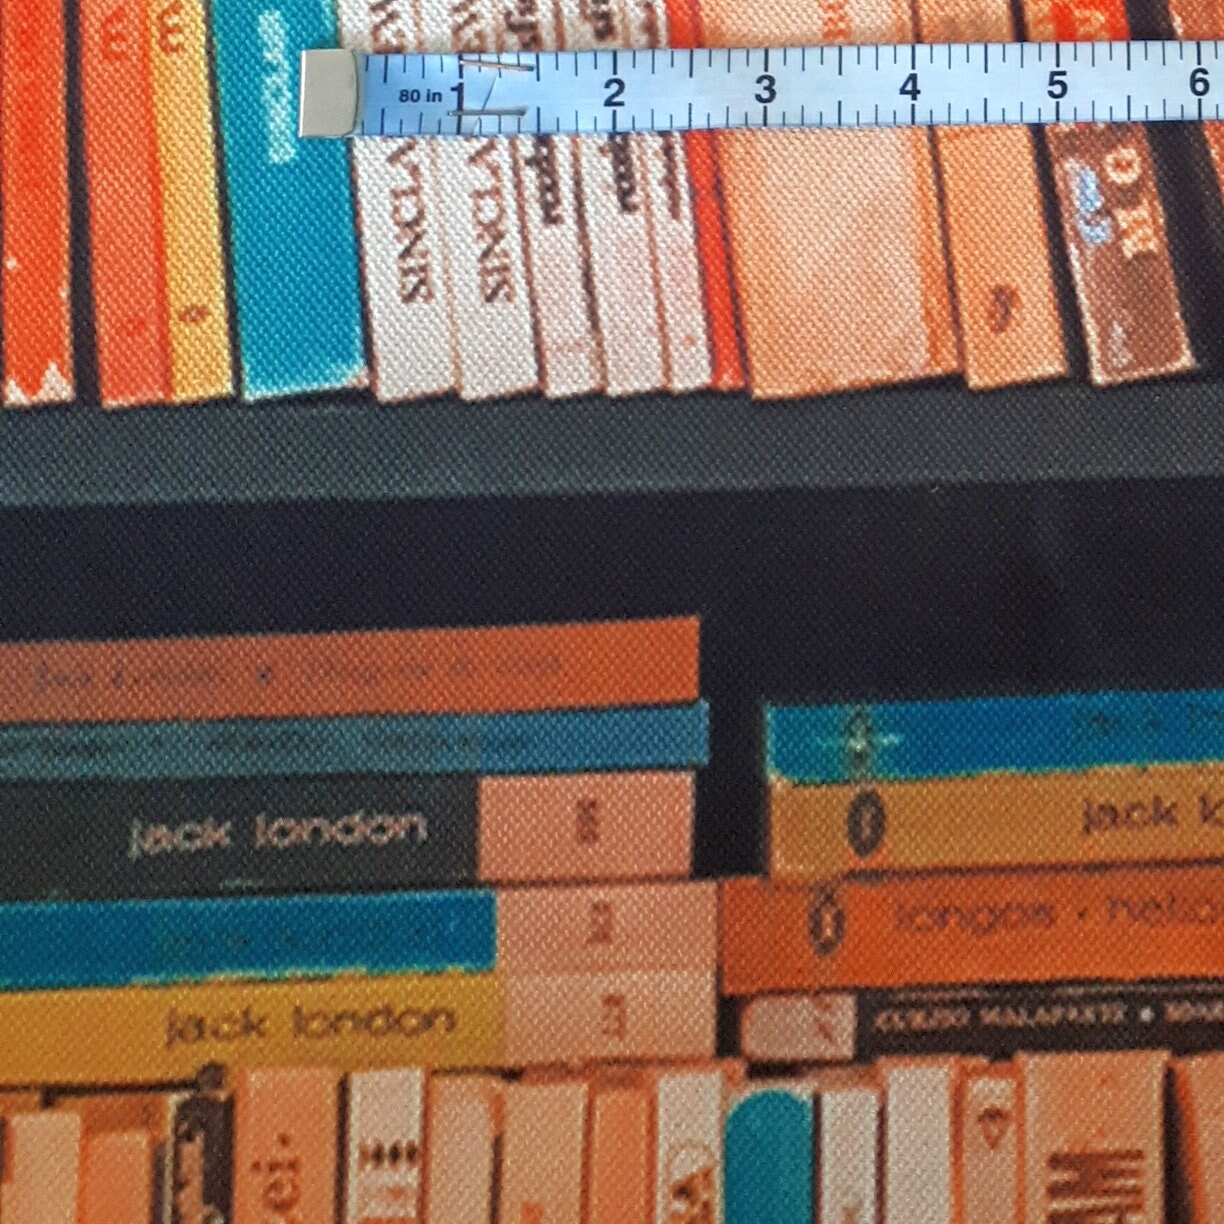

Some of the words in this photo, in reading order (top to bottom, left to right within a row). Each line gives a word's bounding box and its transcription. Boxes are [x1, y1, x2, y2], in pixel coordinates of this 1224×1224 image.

[399, 87, 422, 105] 80
[426, 86, 442, 104] in
[450, 85, 466, 112] 1
[603, 79, 627, 108] 2
[754, 75, 777, 103] 3
[899, 73, 922, 102] 4
[1046, 70, 1070, 101] 5
[1189, 68, 1212, 98] 6
[130, 816, 232, 860] jack
[254, 810, 428, 847] london
[1081, 792, 1180, 836] jack
[165, 1009, 267, 1047] jack
[293, 1003, 457, 1038] london
